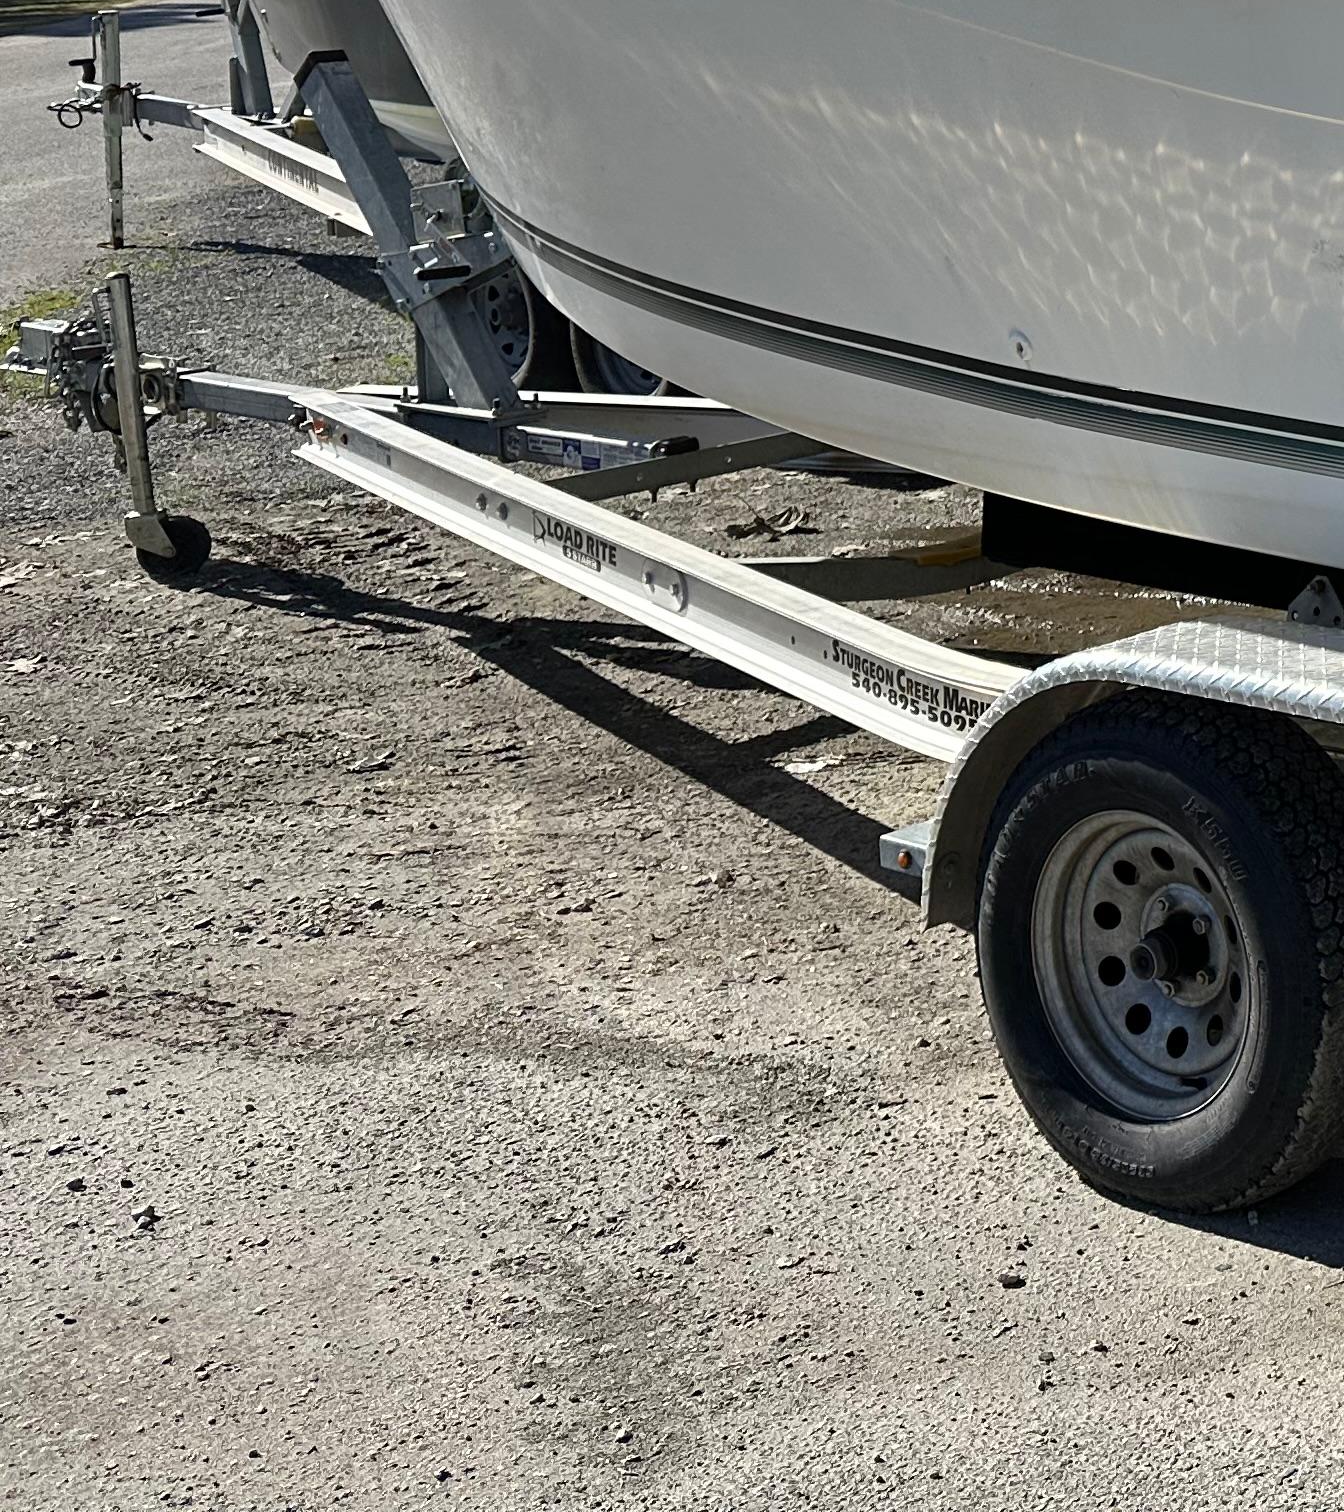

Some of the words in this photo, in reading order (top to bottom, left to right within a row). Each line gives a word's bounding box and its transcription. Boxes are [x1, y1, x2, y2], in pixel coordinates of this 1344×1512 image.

[546, 516, 583, 550] LOAD
[586, 534, 617, 568] RITE
[832, 639, 894, 688] STURGEON
[896, 669, 941, 708] CREEK
